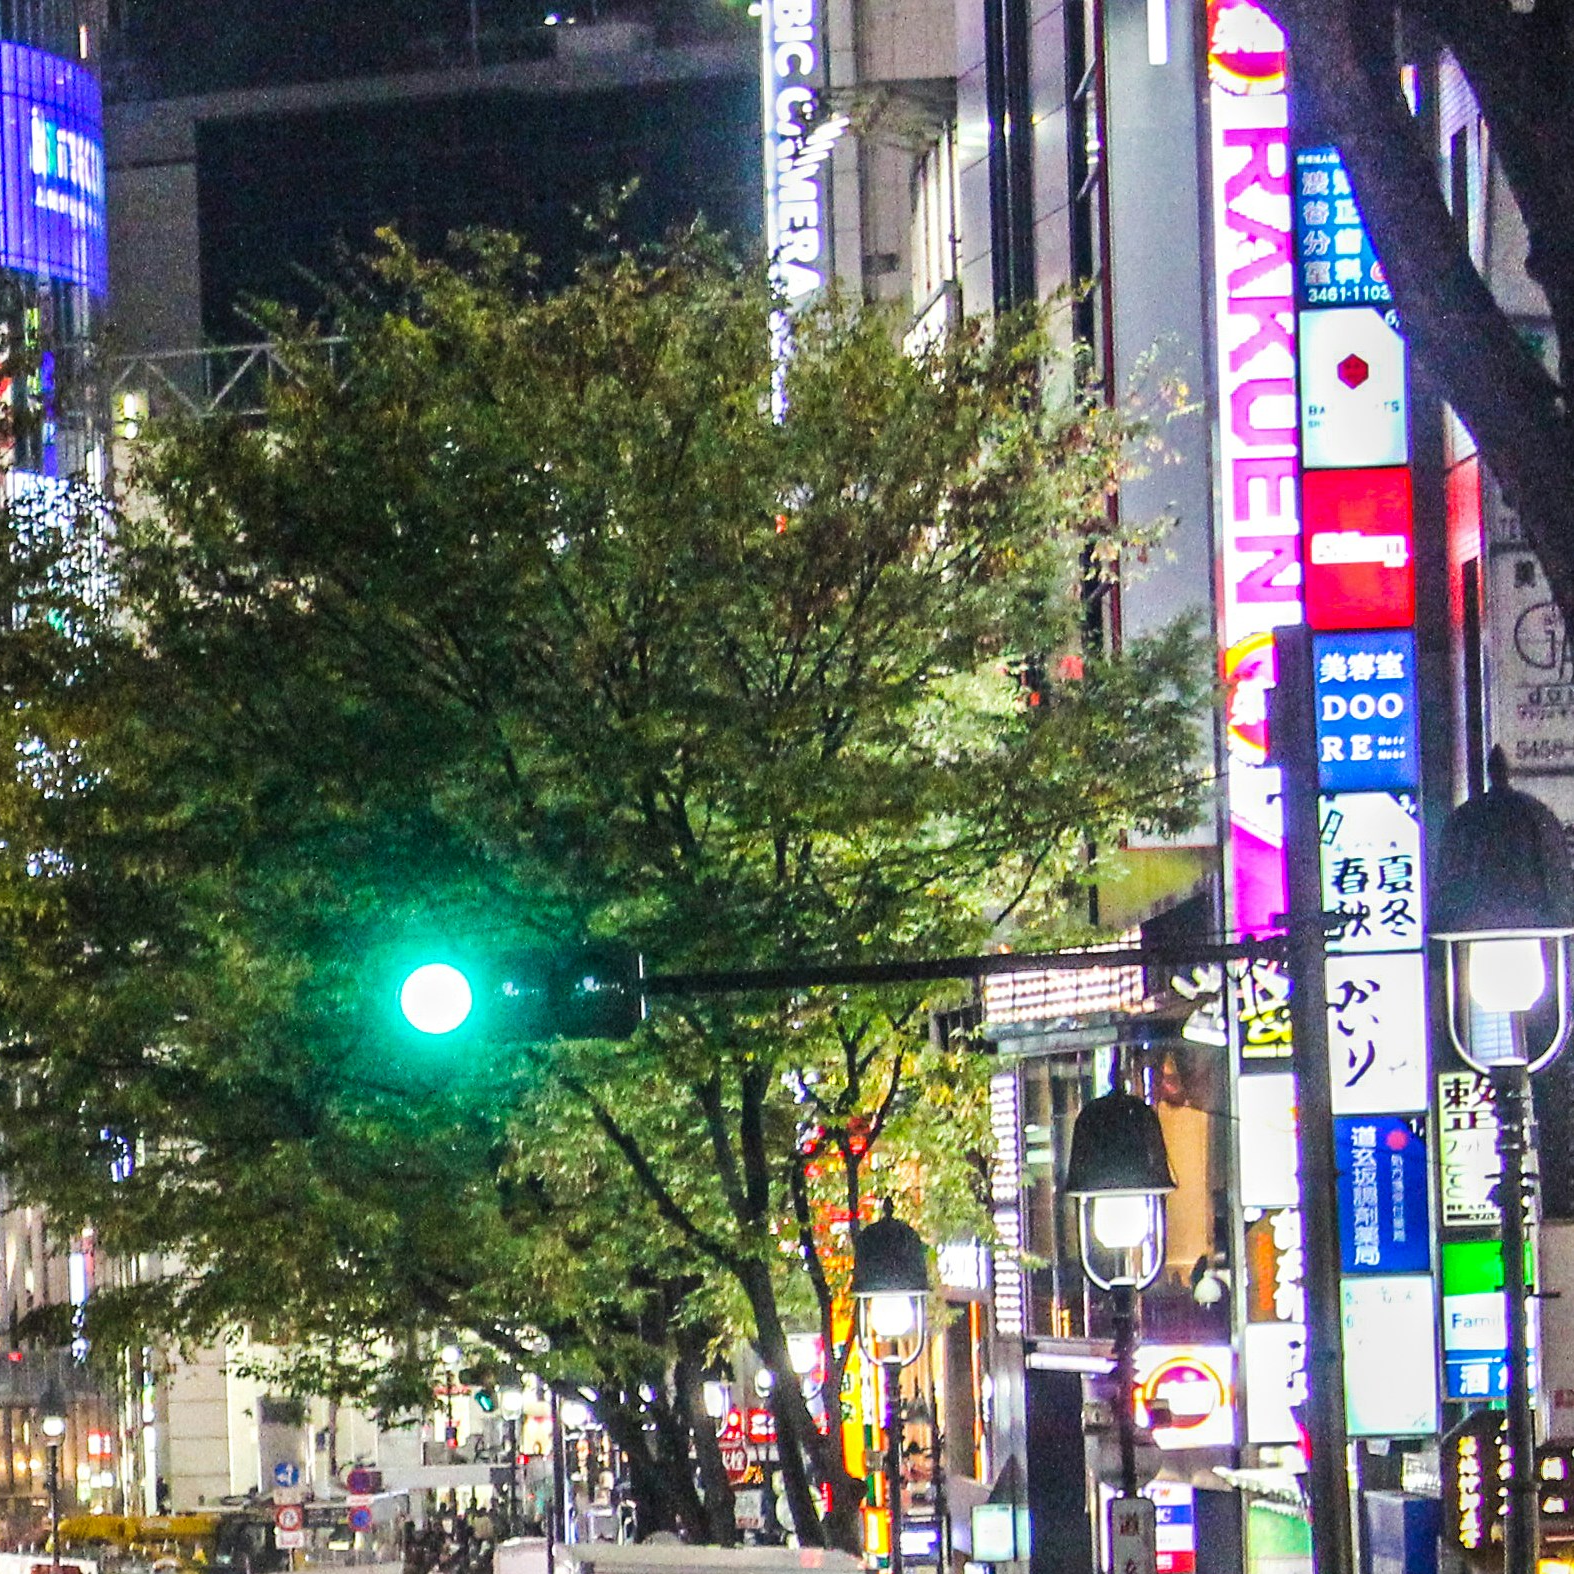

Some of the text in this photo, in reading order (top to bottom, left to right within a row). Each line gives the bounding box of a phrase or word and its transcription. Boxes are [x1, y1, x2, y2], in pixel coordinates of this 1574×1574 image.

[1221, 127, 1298, 606] RAKUEN
[1319, 650, 1405, 684] 美容室
[1321, 692, 1404, 722] DOO
